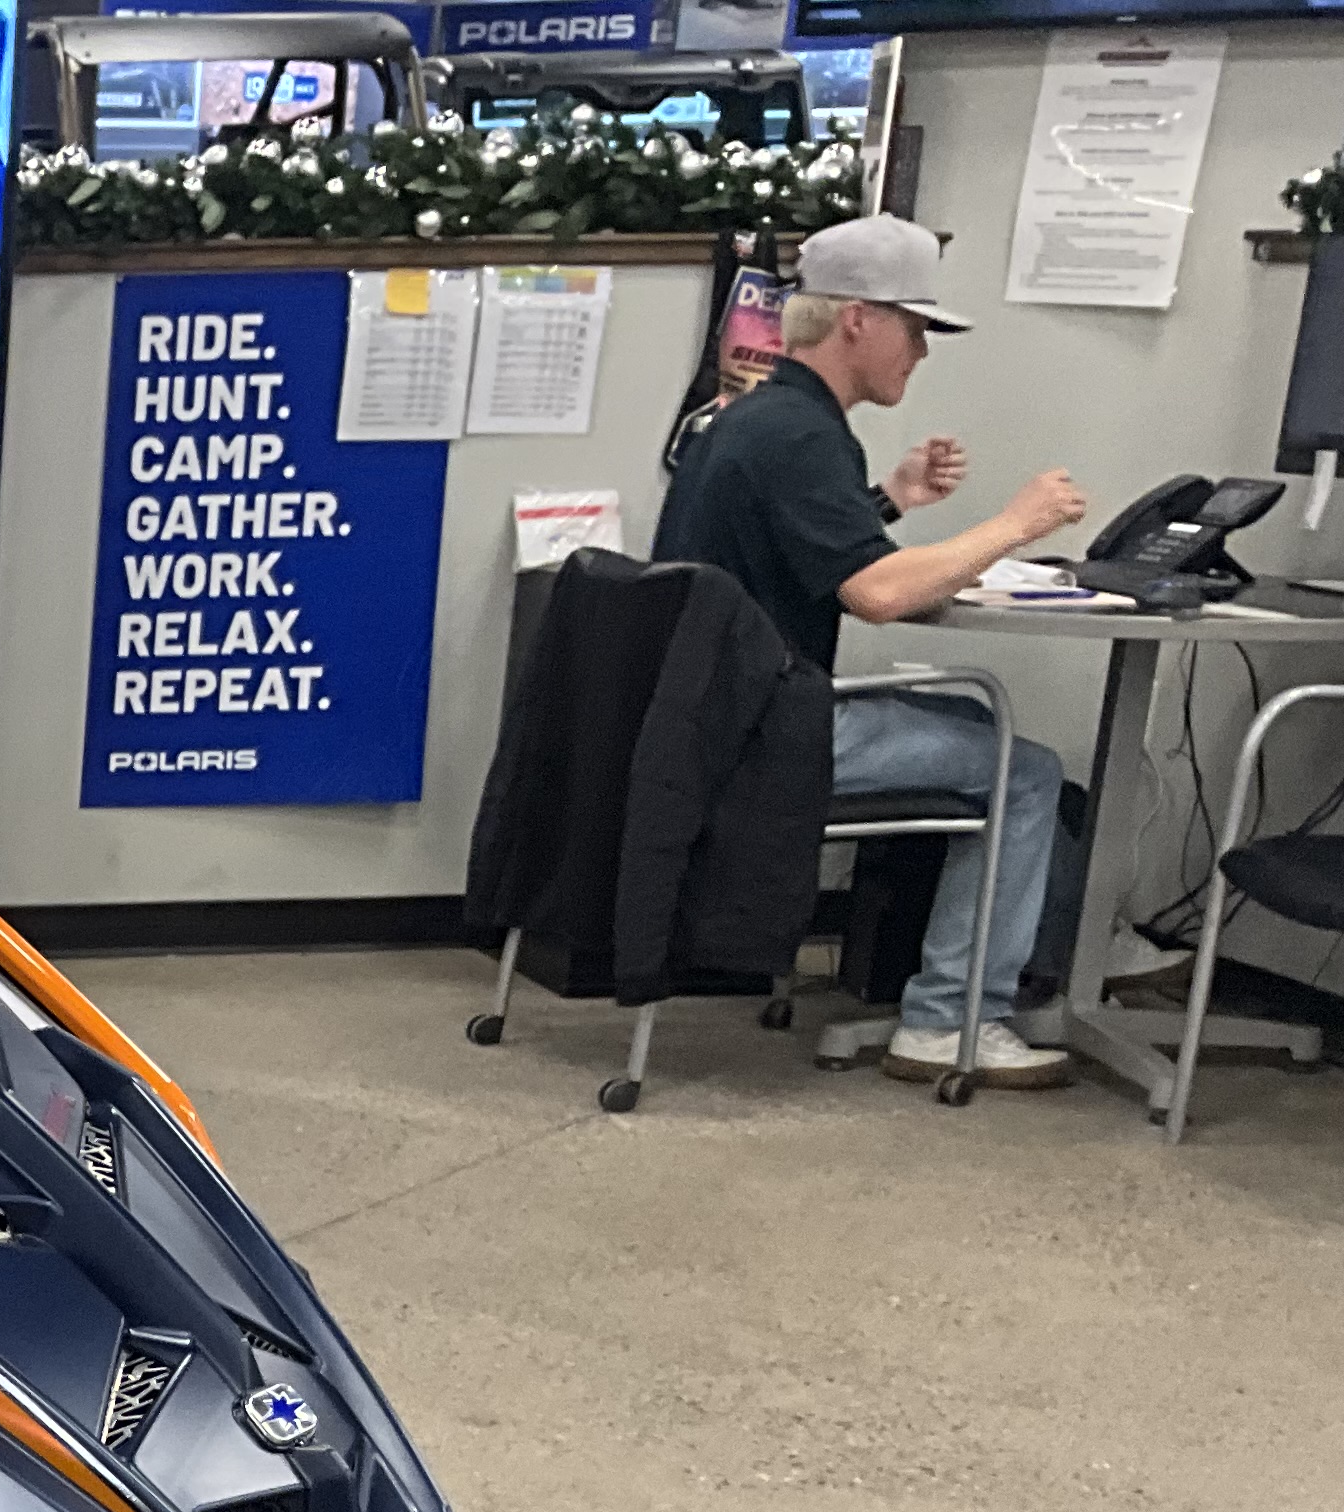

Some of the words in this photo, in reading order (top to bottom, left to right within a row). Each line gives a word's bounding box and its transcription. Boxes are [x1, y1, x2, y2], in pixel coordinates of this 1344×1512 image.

[459, 14, 636, 47] POLARIS
[138, 313, 276, 363] RIDE.
[133, 374, 291, 423] HUNT.
[130, 434, 297, 482] CAMP.
[126, 492, 352, 542] GATHER.
[123, 551, 295, 599] WORK.
[117, 609, 314, 658] RELAX.
[113, 665, 331, 715] REPEAT.
[109, 749, 258, 773] POLARIS
